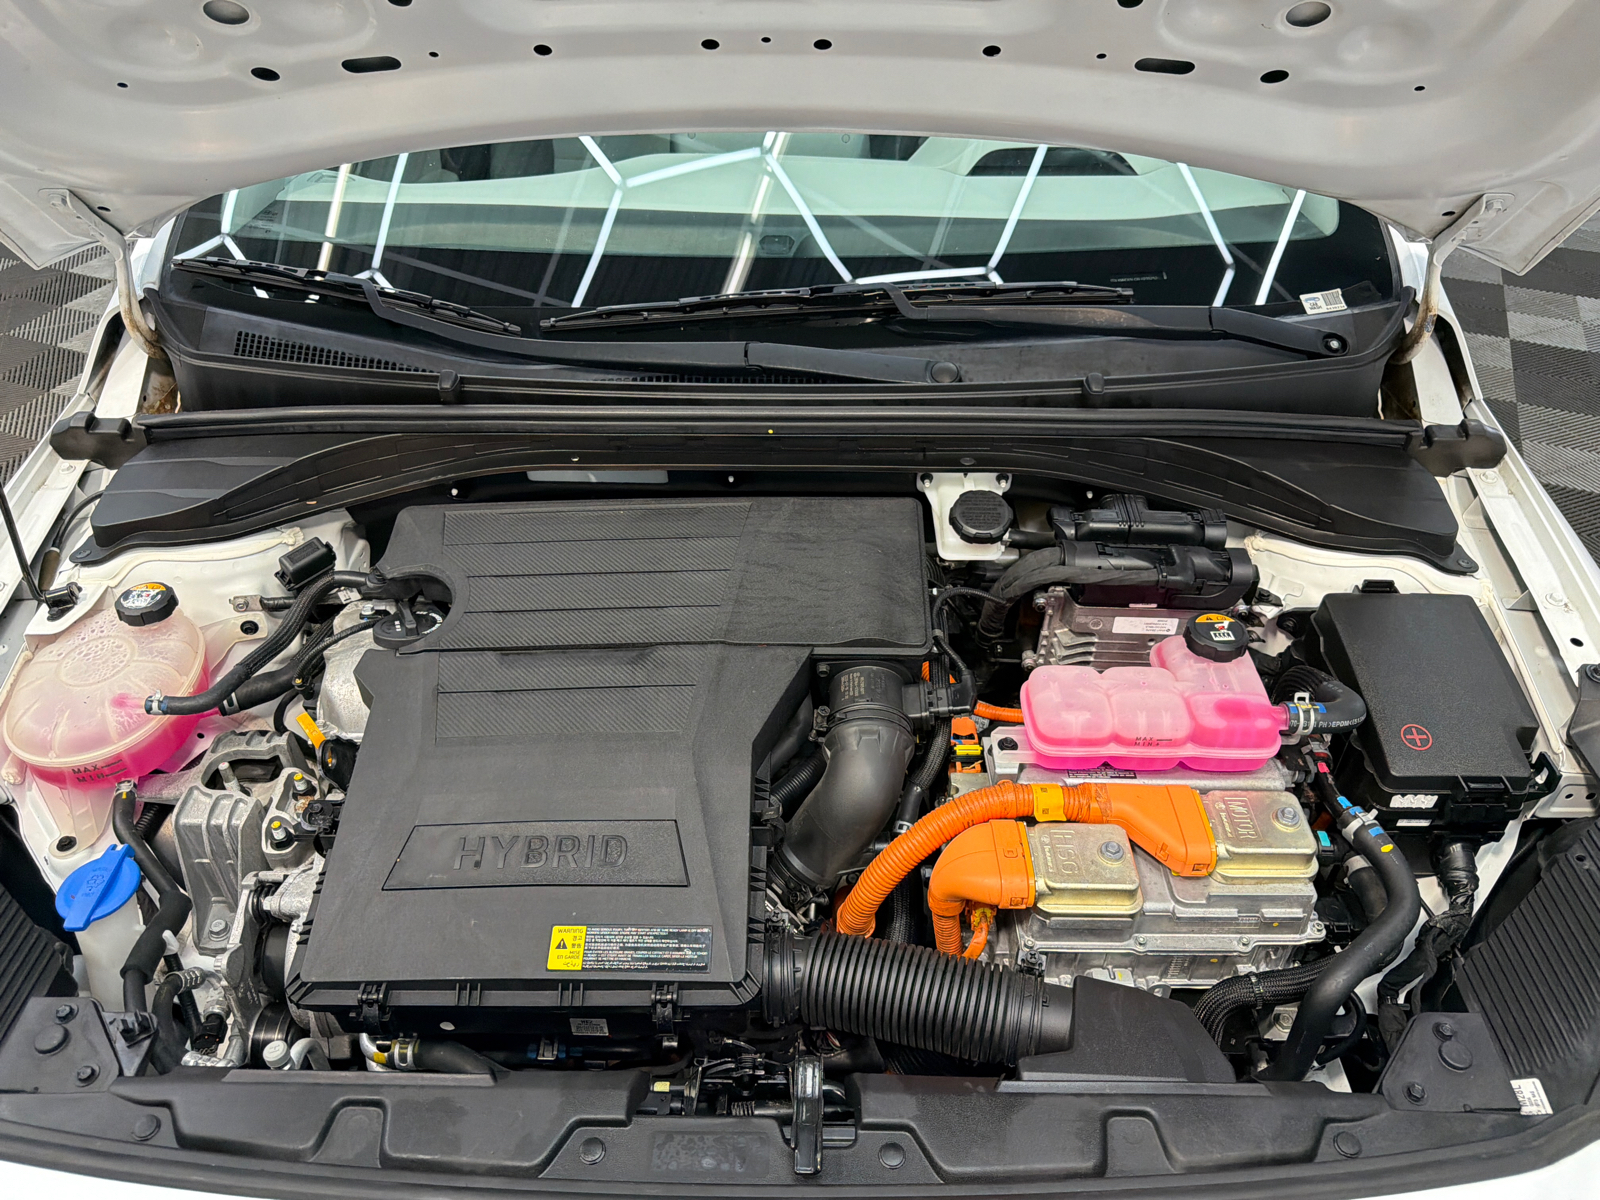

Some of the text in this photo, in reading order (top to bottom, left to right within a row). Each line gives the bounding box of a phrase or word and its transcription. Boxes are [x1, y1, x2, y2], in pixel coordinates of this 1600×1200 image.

[71, 764, 99, 775] MAX
[76, 773, 105, 783] MIN
[1227, 801, 1258, 839] MOTOR
[452, 834, 629, 870] HYBRID
